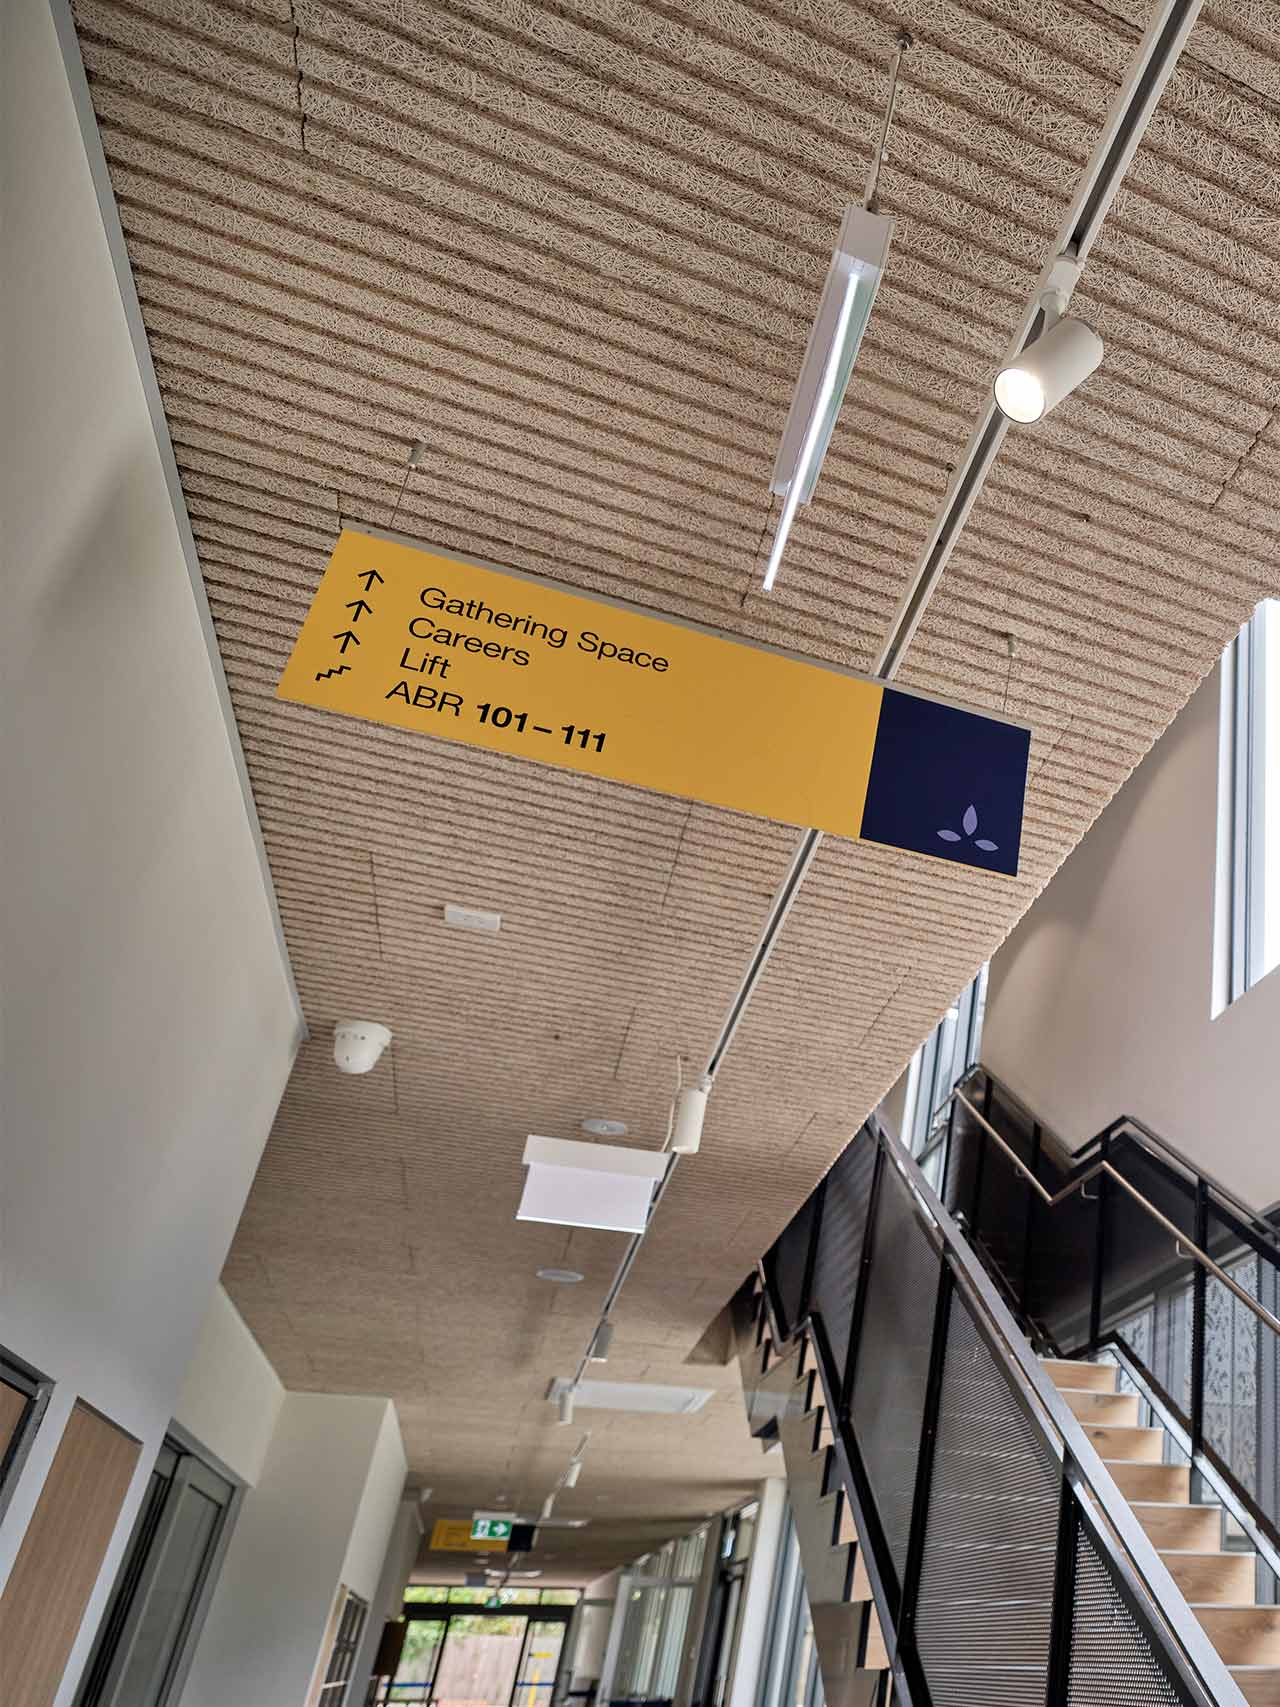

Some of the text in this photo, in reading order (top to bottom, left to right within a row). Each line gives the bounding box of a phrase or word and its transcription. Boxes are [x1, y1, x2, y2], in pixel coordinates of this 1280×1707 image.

[408, 617, 530, 666] Careers
[419, 587, 669, 673] Gathering Space
[399, 647, 452, 679] Lift
[384, 680, 464, 717] ABR
